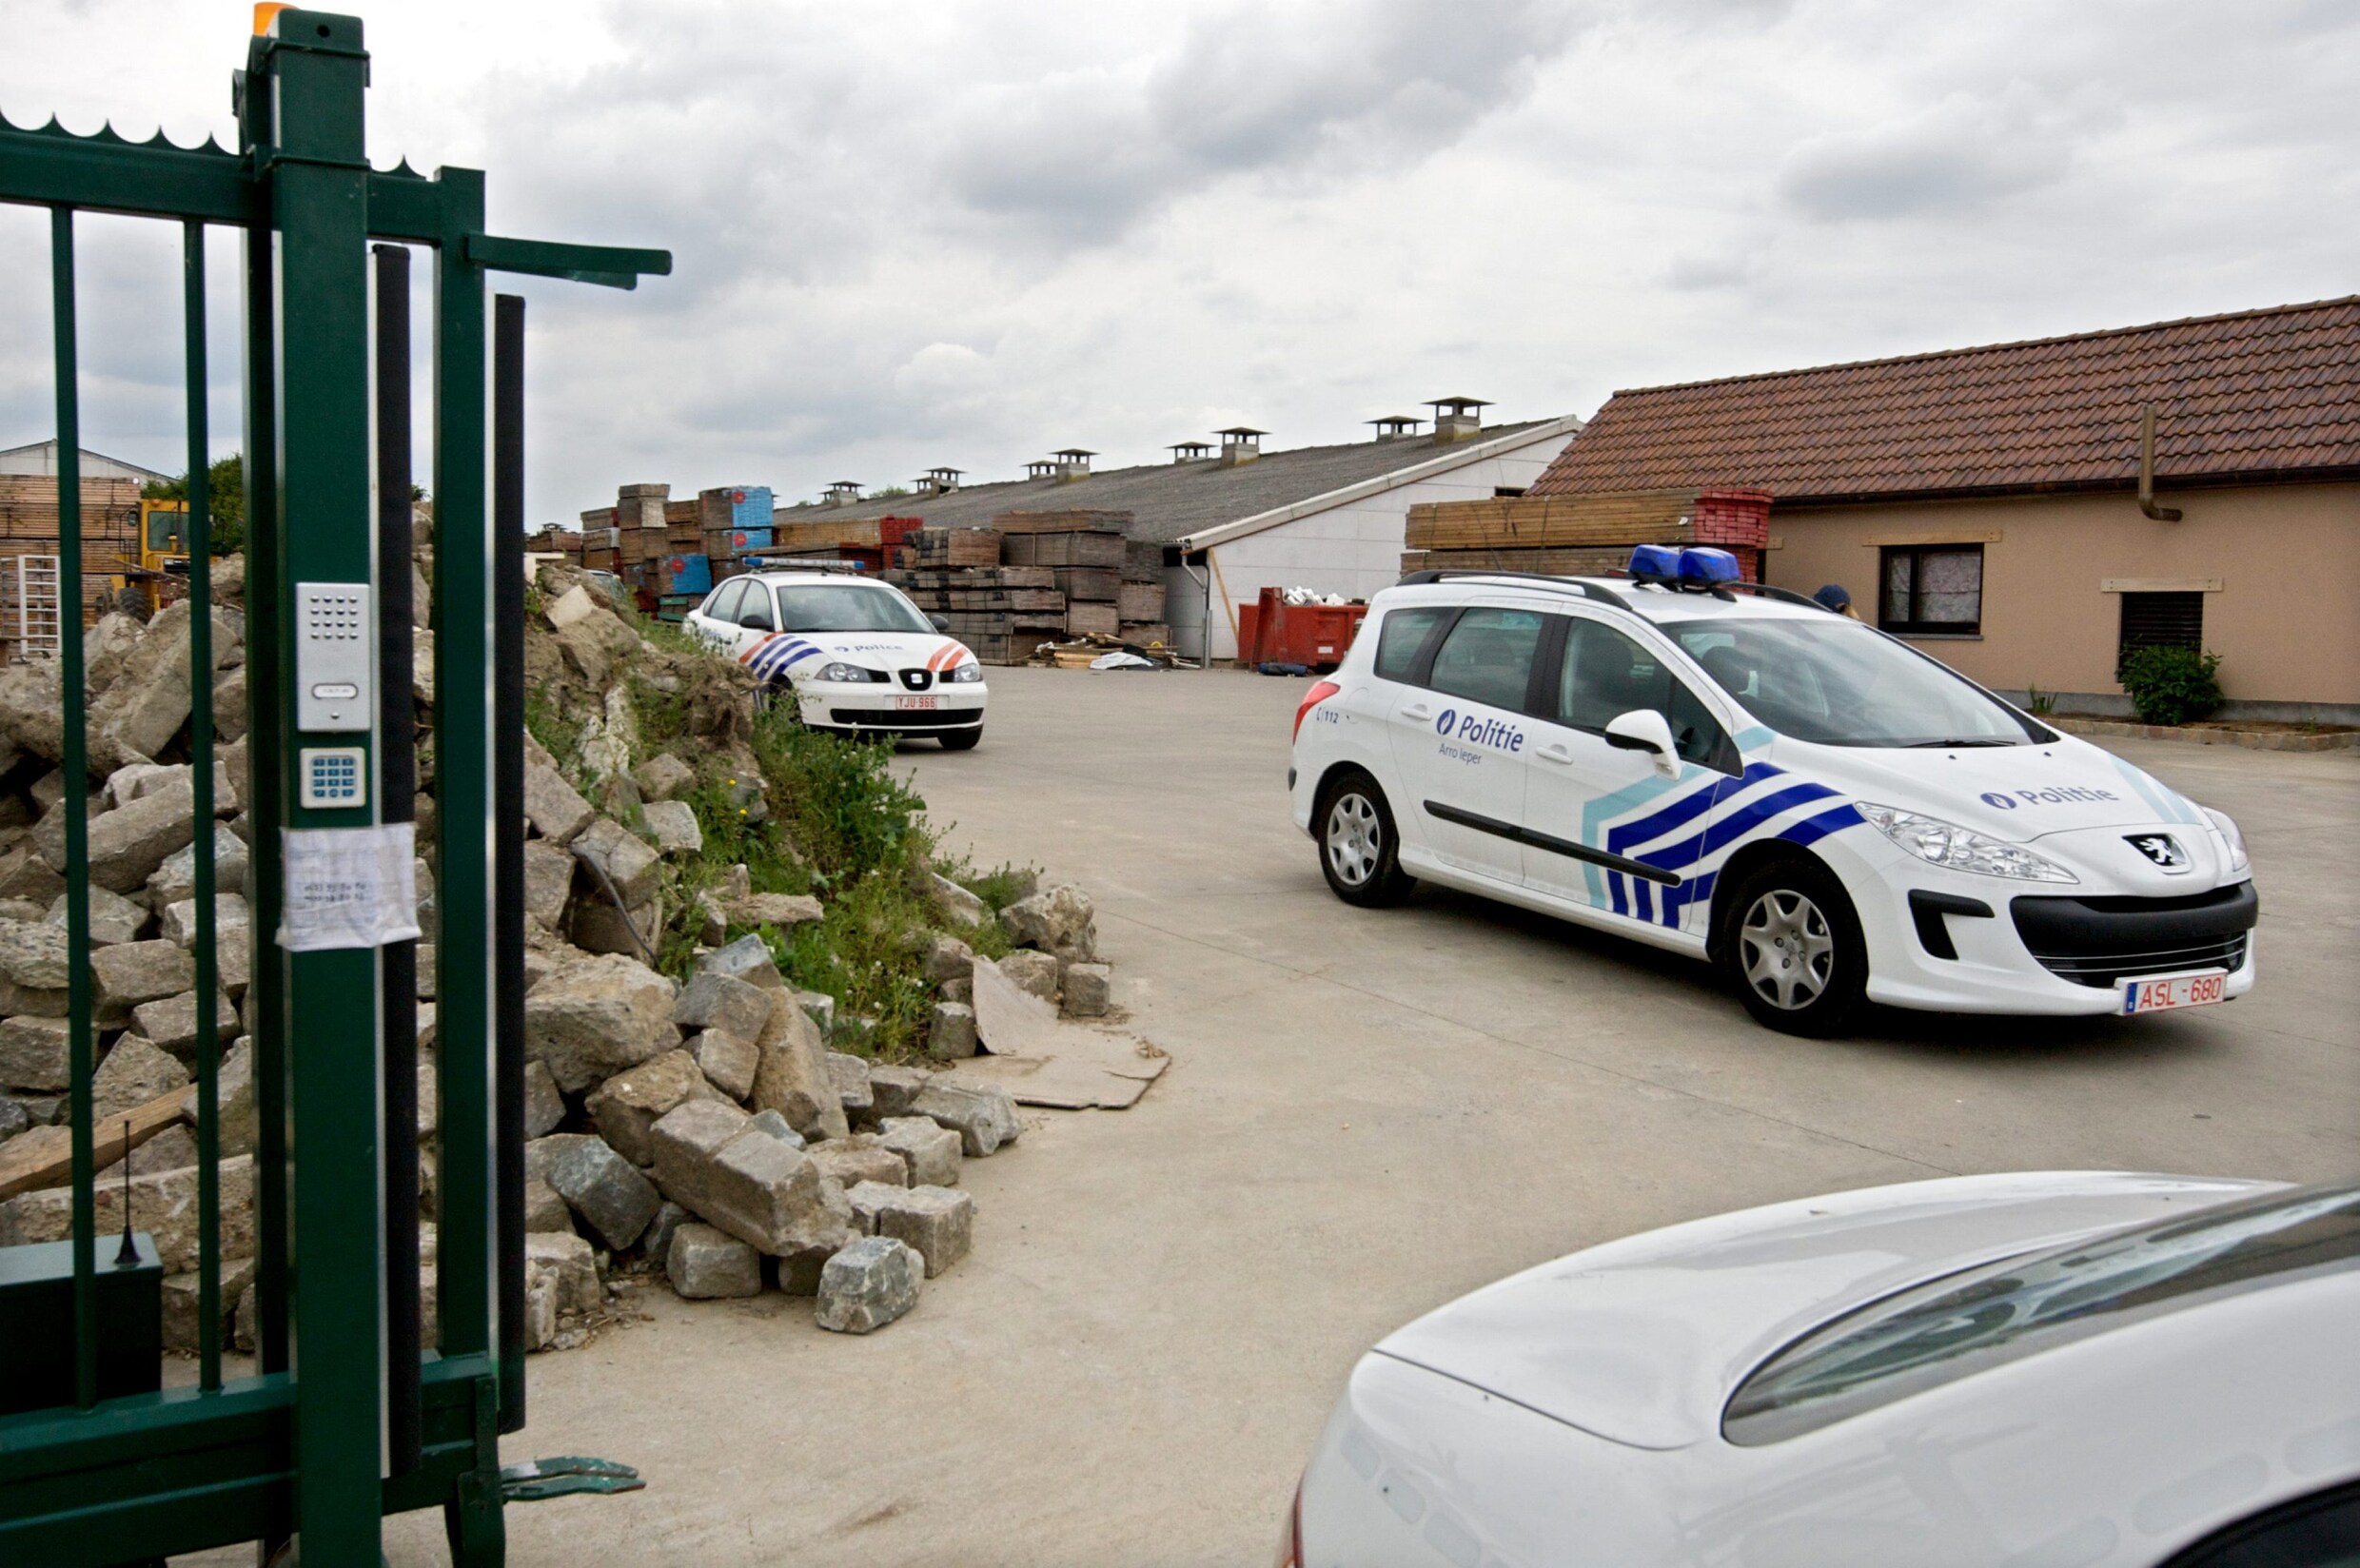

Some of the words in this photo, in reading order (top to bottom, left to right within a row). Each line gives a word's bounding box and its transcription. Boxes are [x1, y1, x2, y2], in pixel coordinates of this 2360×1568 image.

[1326, 711, 1339, 723] 112
[1458, 715, 1524, 752] Politie
[1439, 743, 1458, 758] Arro
[1459, 747, 1483, 766] Ieper
[2015, 787, 2120, 805] Politie
